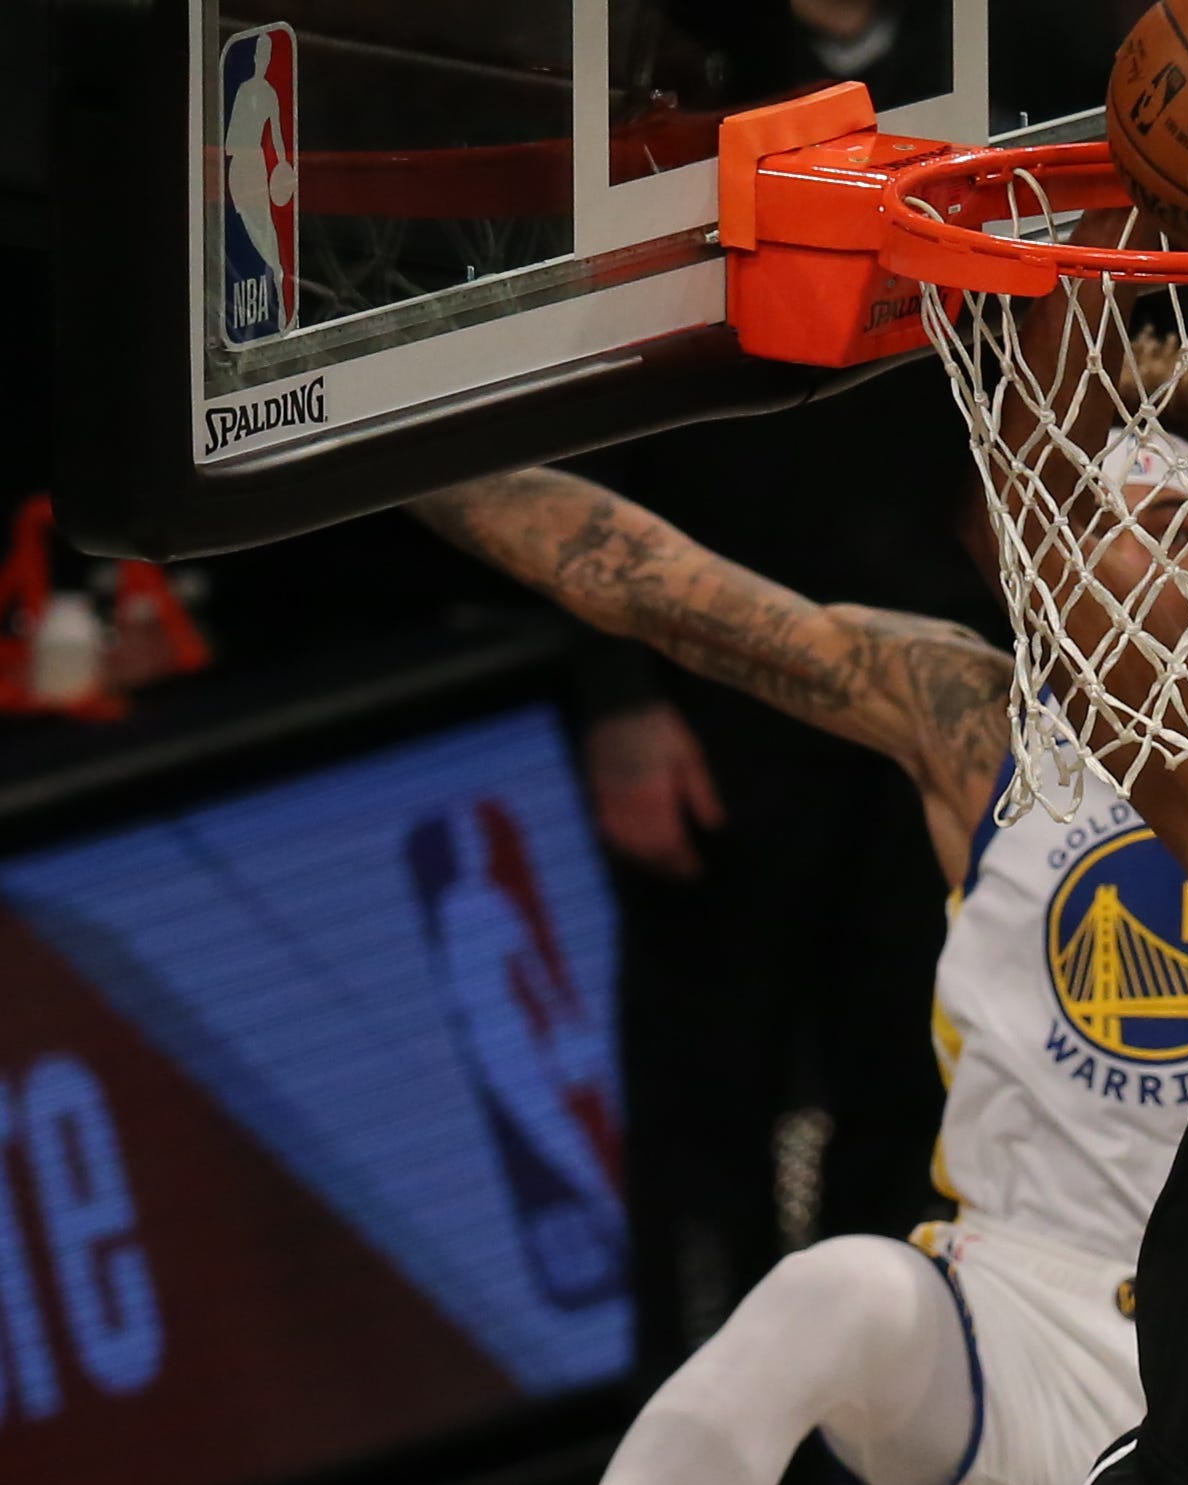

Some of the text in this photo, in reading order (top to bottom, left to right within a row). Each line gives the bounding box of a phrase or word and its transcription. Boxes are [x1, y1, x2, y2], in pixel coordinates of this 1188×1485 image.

[233, 275, 269, 329] NBA
[205, 376, 325, 456] SPALDING
[1048, 803, 1132, 869] GOLD
